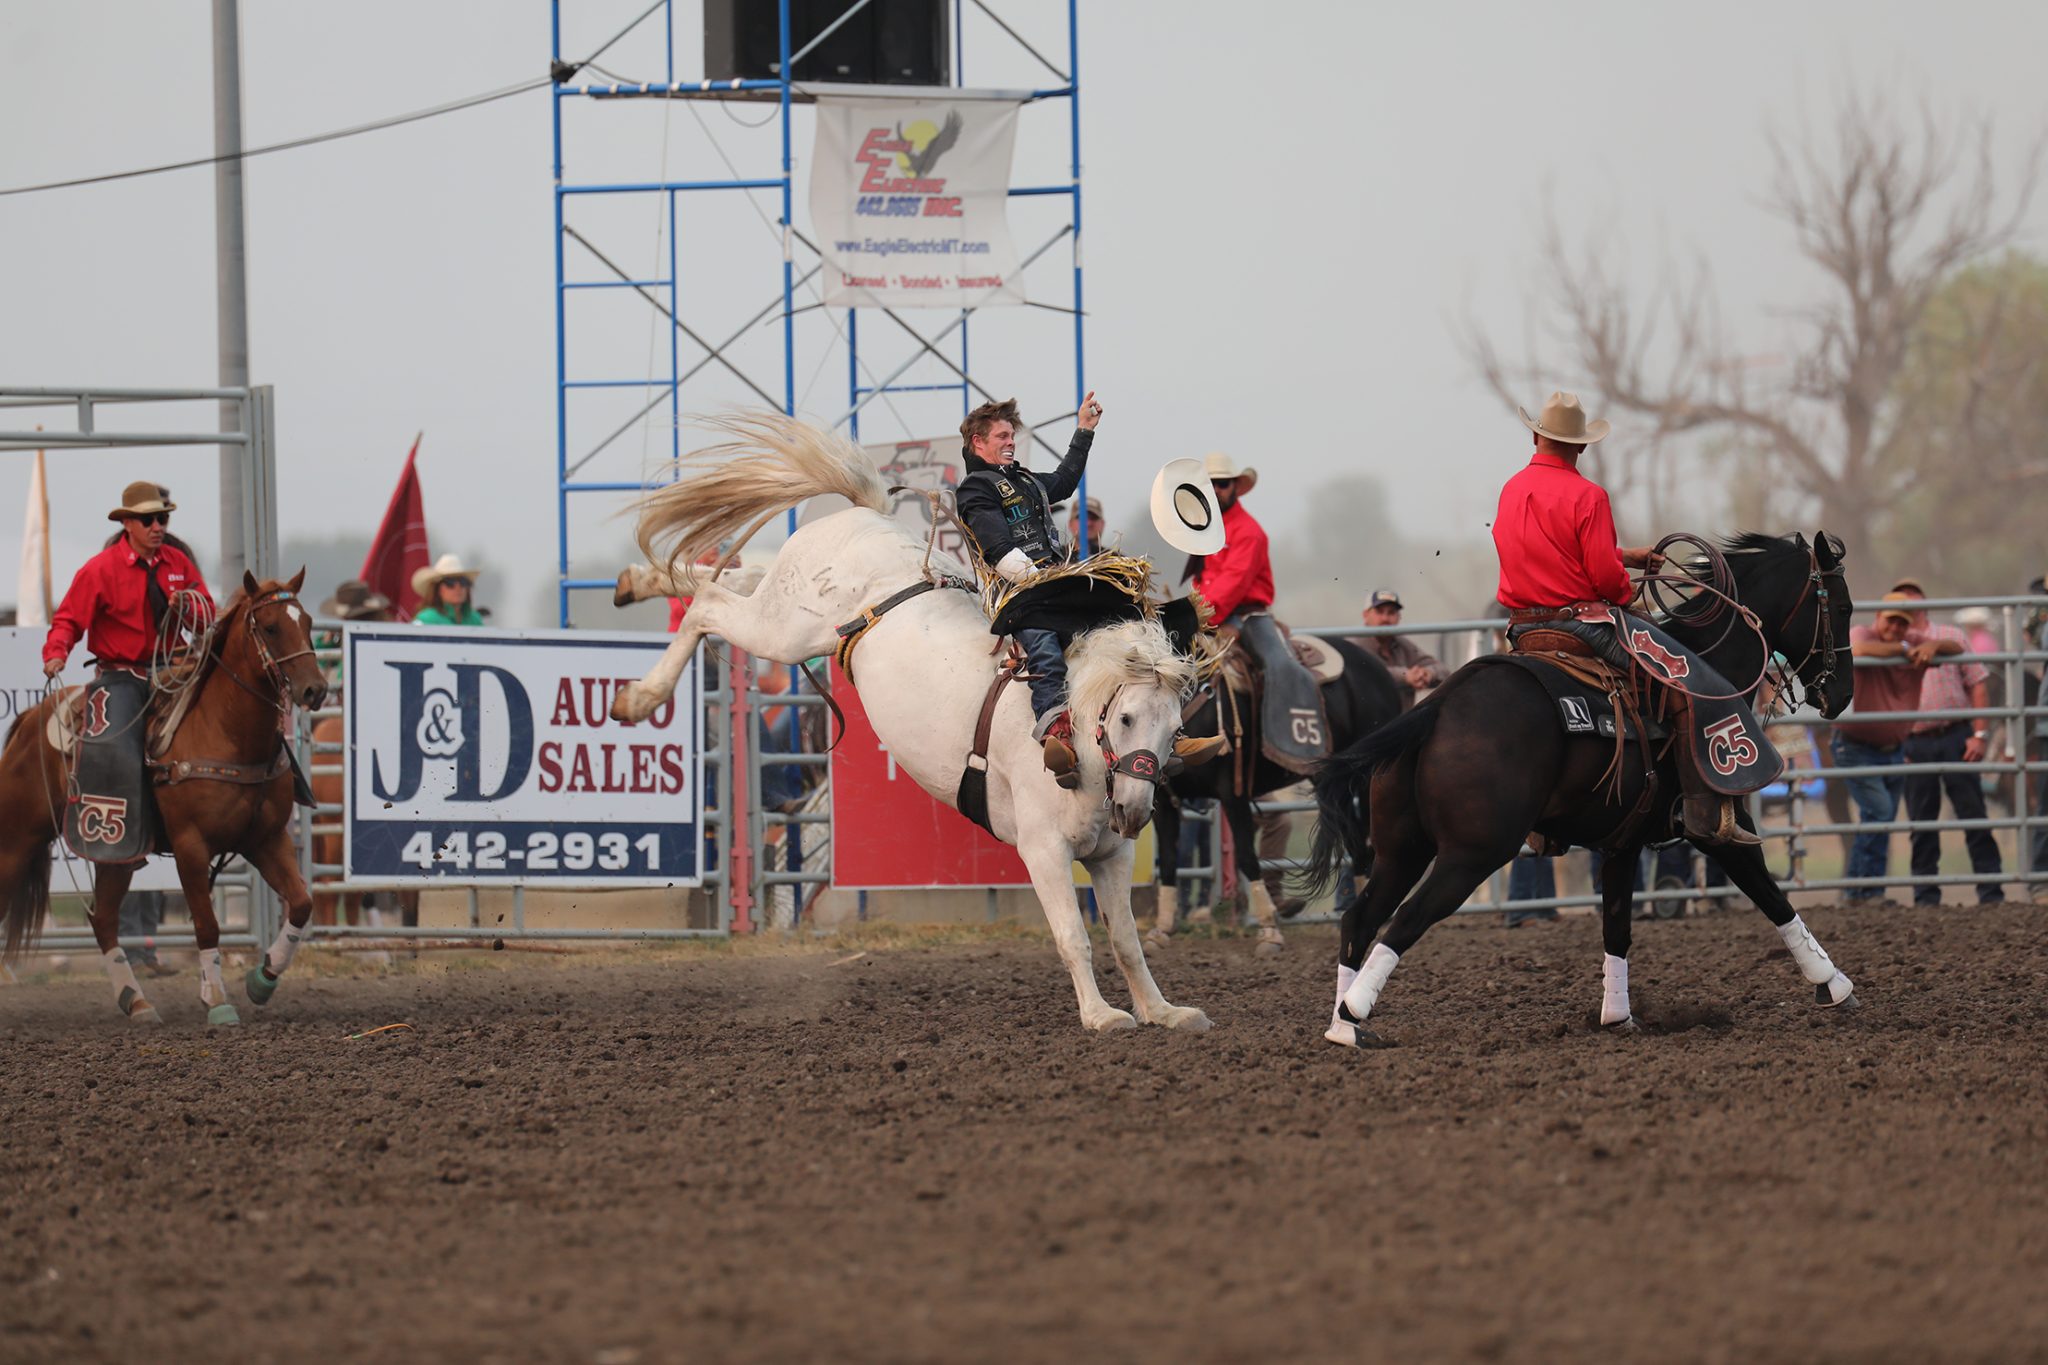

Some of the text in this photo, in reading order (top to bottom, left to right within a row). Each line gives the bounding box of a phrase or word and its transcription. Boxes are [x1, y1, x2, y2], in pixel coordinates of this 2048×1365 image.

[835, 238, 990, 258] www.EagleElectricMT.com
[1291, 717, 1323, 746] C5
[1707, 722, 1759, 776] C5
[538, 741, 685, 795] SALES
[1131, 755, 1155, 775] C5
[78, 803, 126, 845] C5
[401, 830, 660, 871] 442-2931
